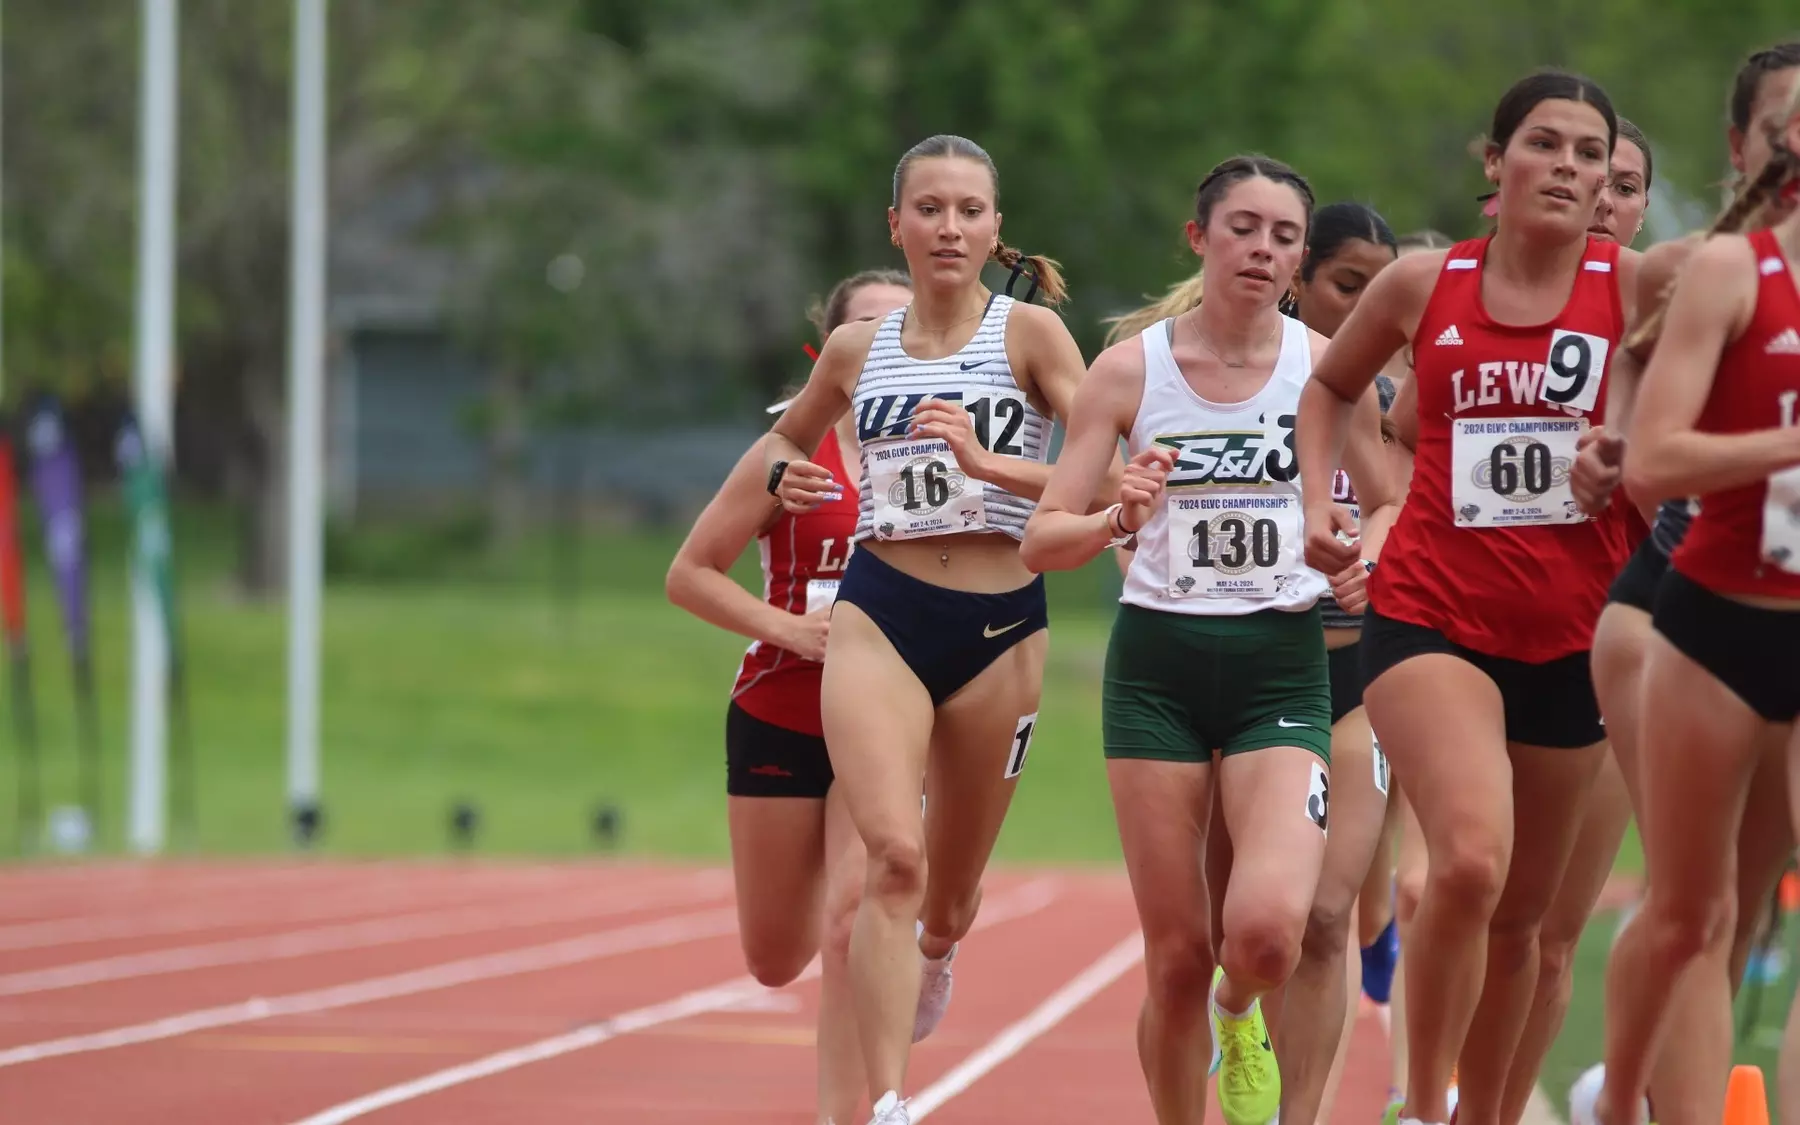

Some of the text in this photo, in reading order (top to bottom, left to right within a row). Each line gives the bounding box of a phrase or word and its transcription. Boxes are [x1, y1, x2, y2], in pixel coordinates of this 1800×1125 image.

[1435, 337, 1464, 346] adidas
[1451, 361, 1584, 418] LEW
[1545, 334, 1592, 404] 9
[964, 397, 1025, 456] 12
[1265, 414, 1300, 482] 3
[1464, 421, 1580, 435] 2024 GLVC CHAMPIONSHIPS
[875, 451, 891, 461] 2024
[892, 447, 910, 458] GLVC
[1490, 443, 1552, 495] 60
[900, 461, 950, 511] 16
[1179, 498, 1289, 509] 2024 GLVC CHAMPIONSHIPS
[930, 518, 943, 526] 2024
[1192, 518, 1279, 568] 130
[817, 581, 836, 589] 2024
[1010, 722, 1036, 774] 1
[1308, 772, 1329, 830] 3
